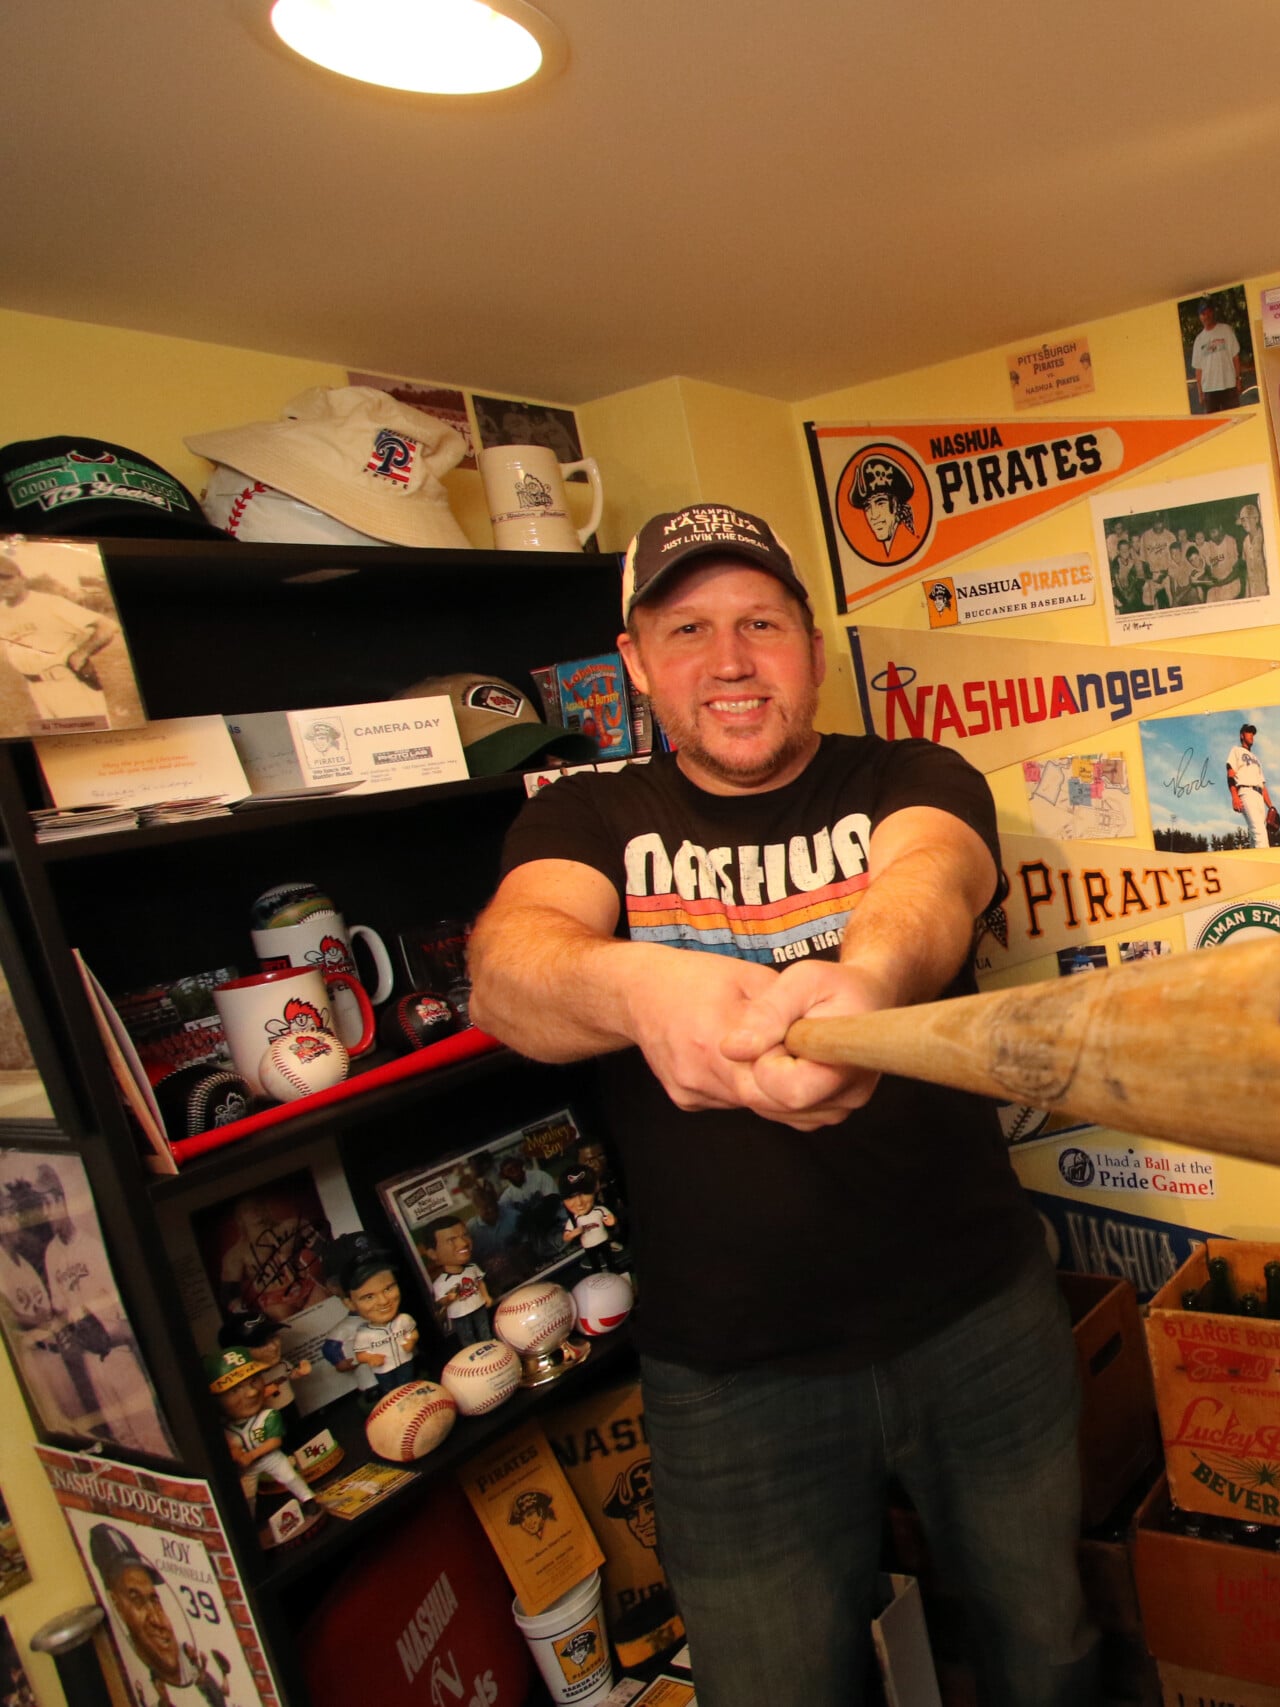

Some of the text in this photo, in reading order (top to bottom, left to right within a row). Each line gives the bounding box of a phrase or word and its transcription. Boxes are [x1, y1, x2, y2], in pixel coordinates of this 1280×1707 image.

[1017, 342, 1077, 367] PITTSBURGH
[1033, 358, 1065, 375] PIRATES
[1025, 374, 1080, 395] NASHUA PIRATES
[929, 426, 1004, 459] NASHUA
[936, 434, 1102, 514] PIRATES
[663, 513, 762, 536] NASHUA
[692, 522, 736, 533] LIFE
[661, 537, 682, 553] JUST
[715, 532, 737, 541] THE
[957, 565, 1093, 600] NASHUA PIRATES
[964, 593, 1087, 620] BUCCANEER BASEBALL
[353, 718, 441, 738] CAMERA DAY
[313, 756, 346, 767] PIRATES
[623, 812, 872, 907] NASHUA
[1018, 858, 1224, 939] PIRATES
[772, 942, 809, 964] NEW
[1095, 1154, 1213, 1174] I had a Ball at the
[1099, 1170, 1216, 1196] Pride Game!
[1163, 1319, 1177, 1337] 6
[1180, 1322, 1241, 1345] LARGE
[469, 1342, 498, 1362] FCBL
[1172, 1396, 1258, 1461] Lucky
[477, 1445, 539, 1495] PIRATES
[52, 1468, 203, 1528] NASHUA DODGERS
[160, 1536, 191, 1565] ROY
[155, 1558, 215, 1586] CAMPANELLA
[180, 1584, 221, 1625] 39
[396, 1569, 459, 1686] NASHUA
